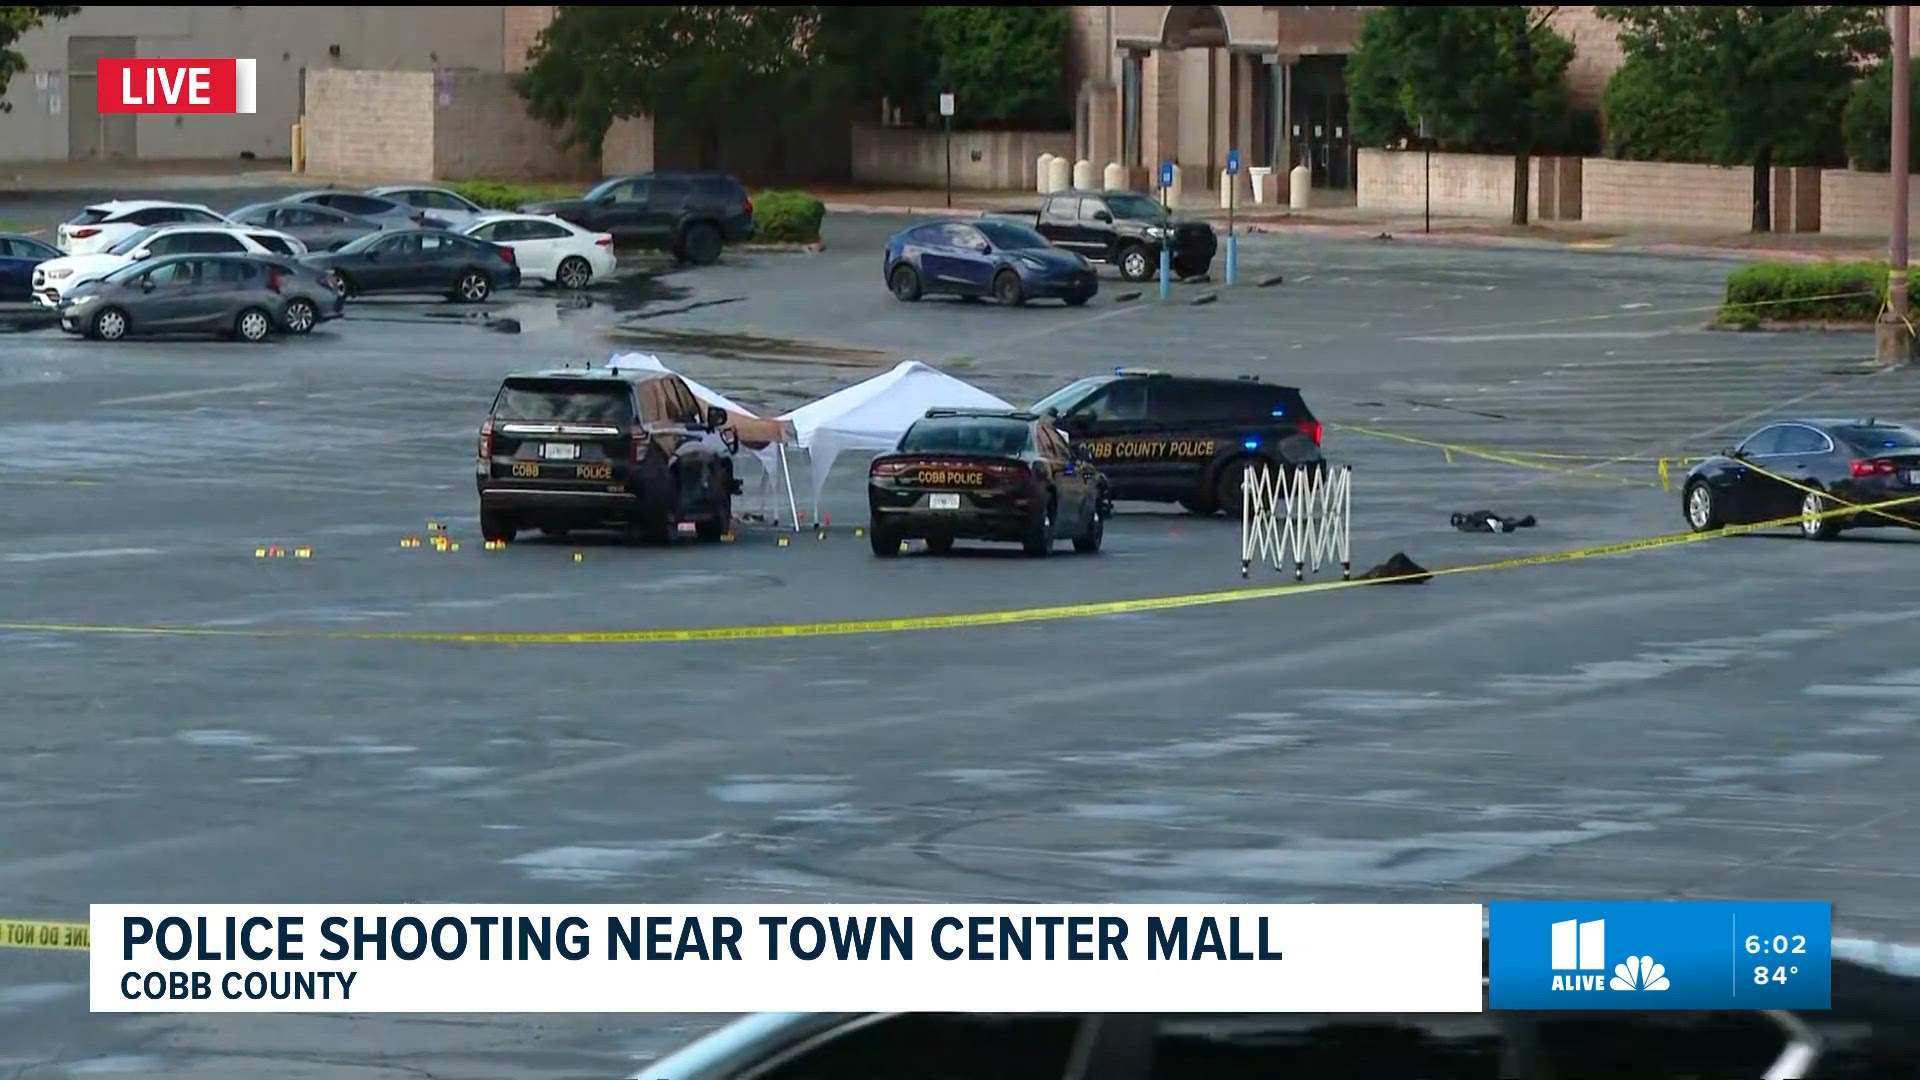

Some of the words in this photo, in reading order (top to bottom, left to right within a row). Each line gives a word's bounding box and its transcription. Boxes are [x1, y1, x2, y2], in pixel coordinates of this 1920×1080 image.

[1116, 441, 1167, 457] COUNTY
[1169, 440, 1215, 455] POLICE
[512, 464, 540, 477] COBB
[576, 466, 612, 479] POLICE
[918, 471, 946, 483] COBB
[947, 472, 983, 485] POLICE
